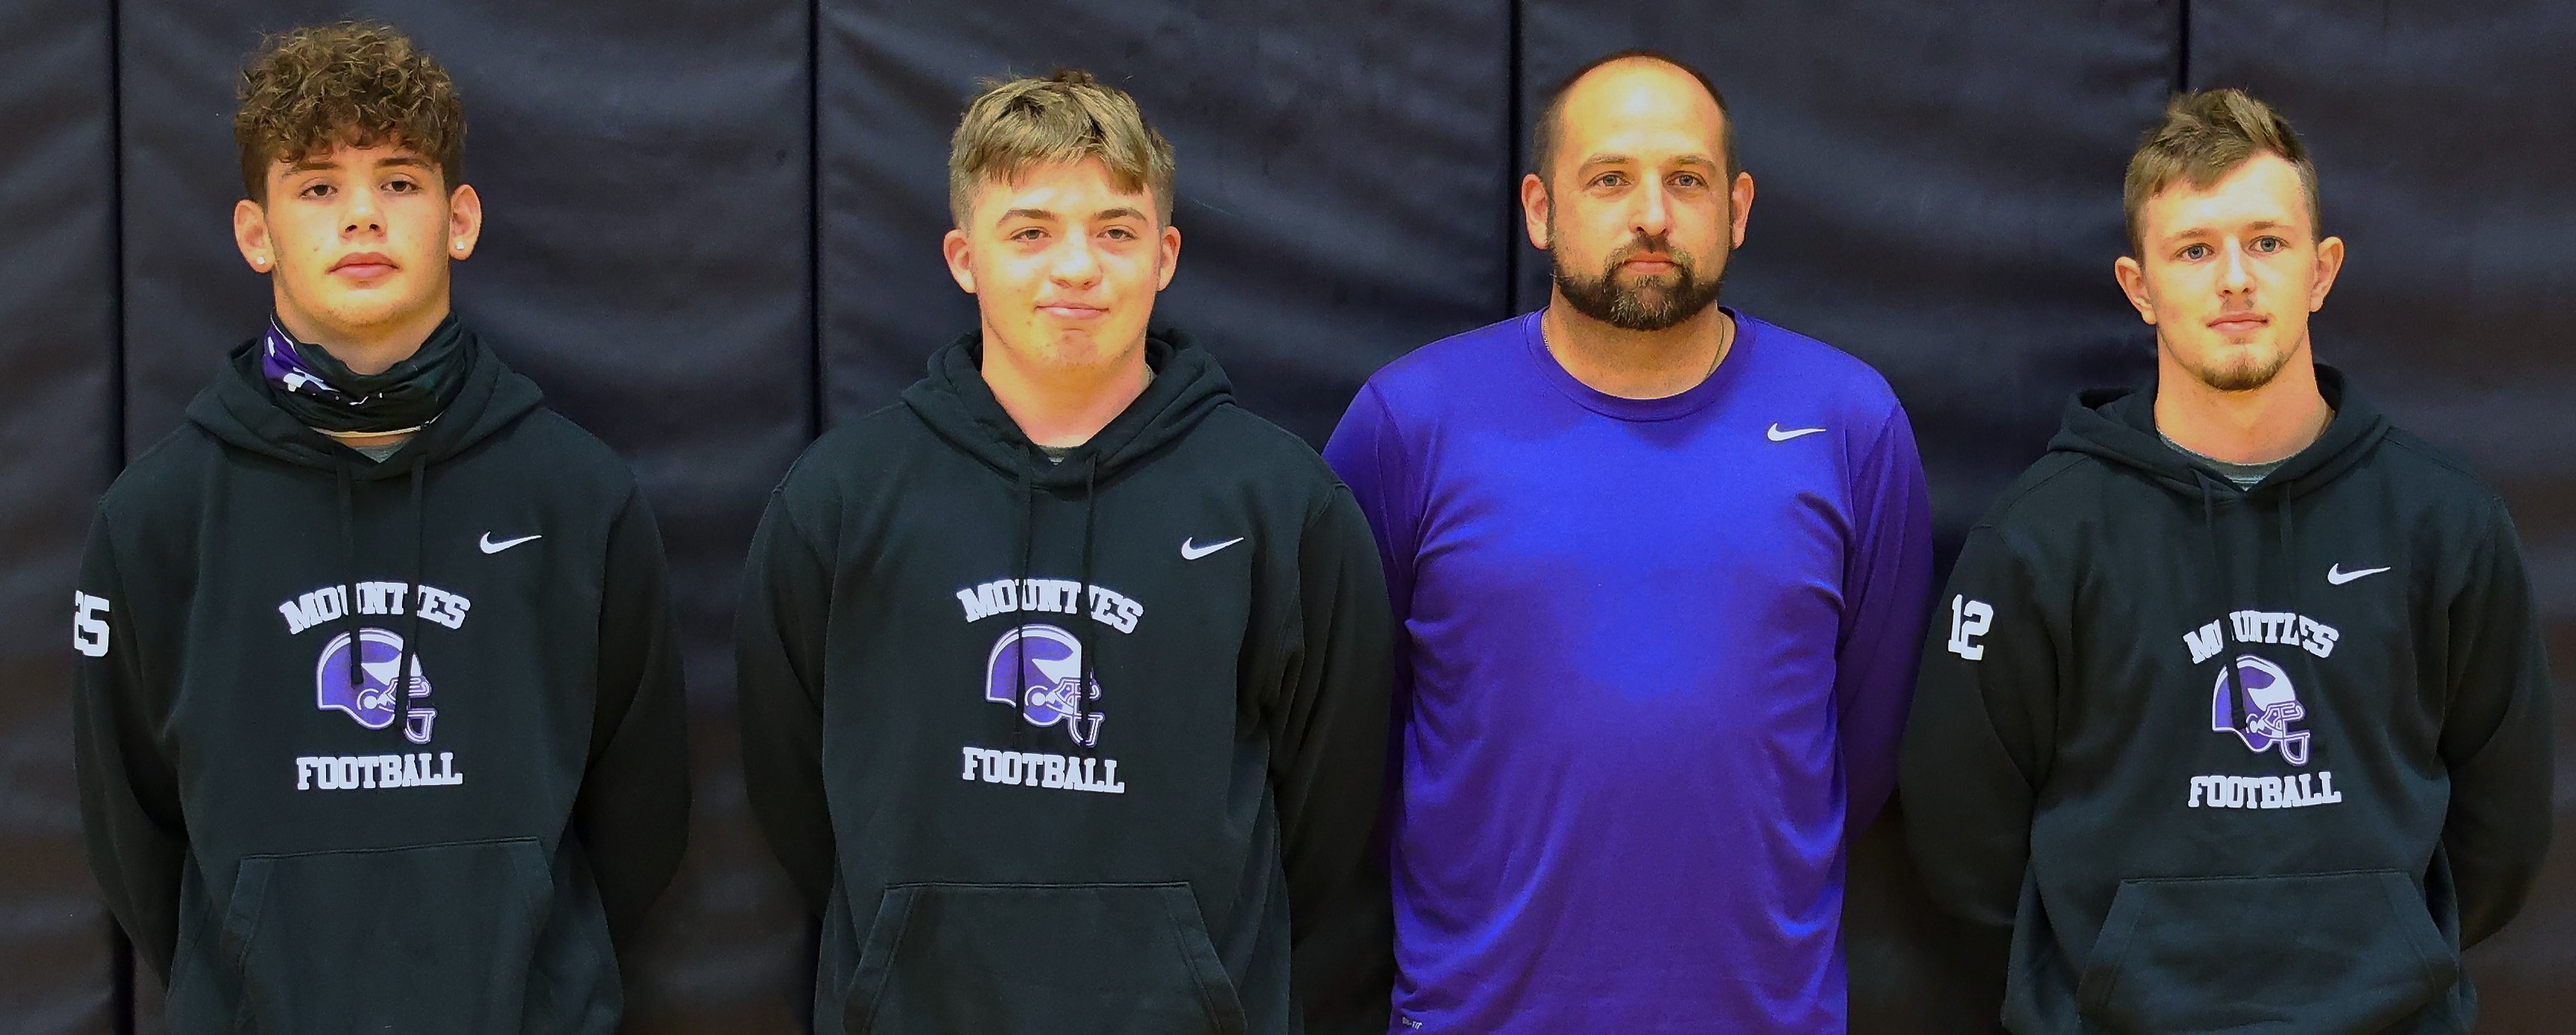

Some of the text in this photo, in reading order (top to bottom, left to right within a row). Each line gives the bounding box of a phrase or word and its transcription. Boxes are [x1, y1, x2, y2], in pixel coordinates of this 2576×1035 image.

[279, 581, 471, 634] MONTES
[1948, 594, 1994, 660] 12
[297, 753, 463, 789] FOOTBALL
[962, 747, 1125, 793] FOOTBALL
[2188, 771, 2342, 809] FOOTBALL
